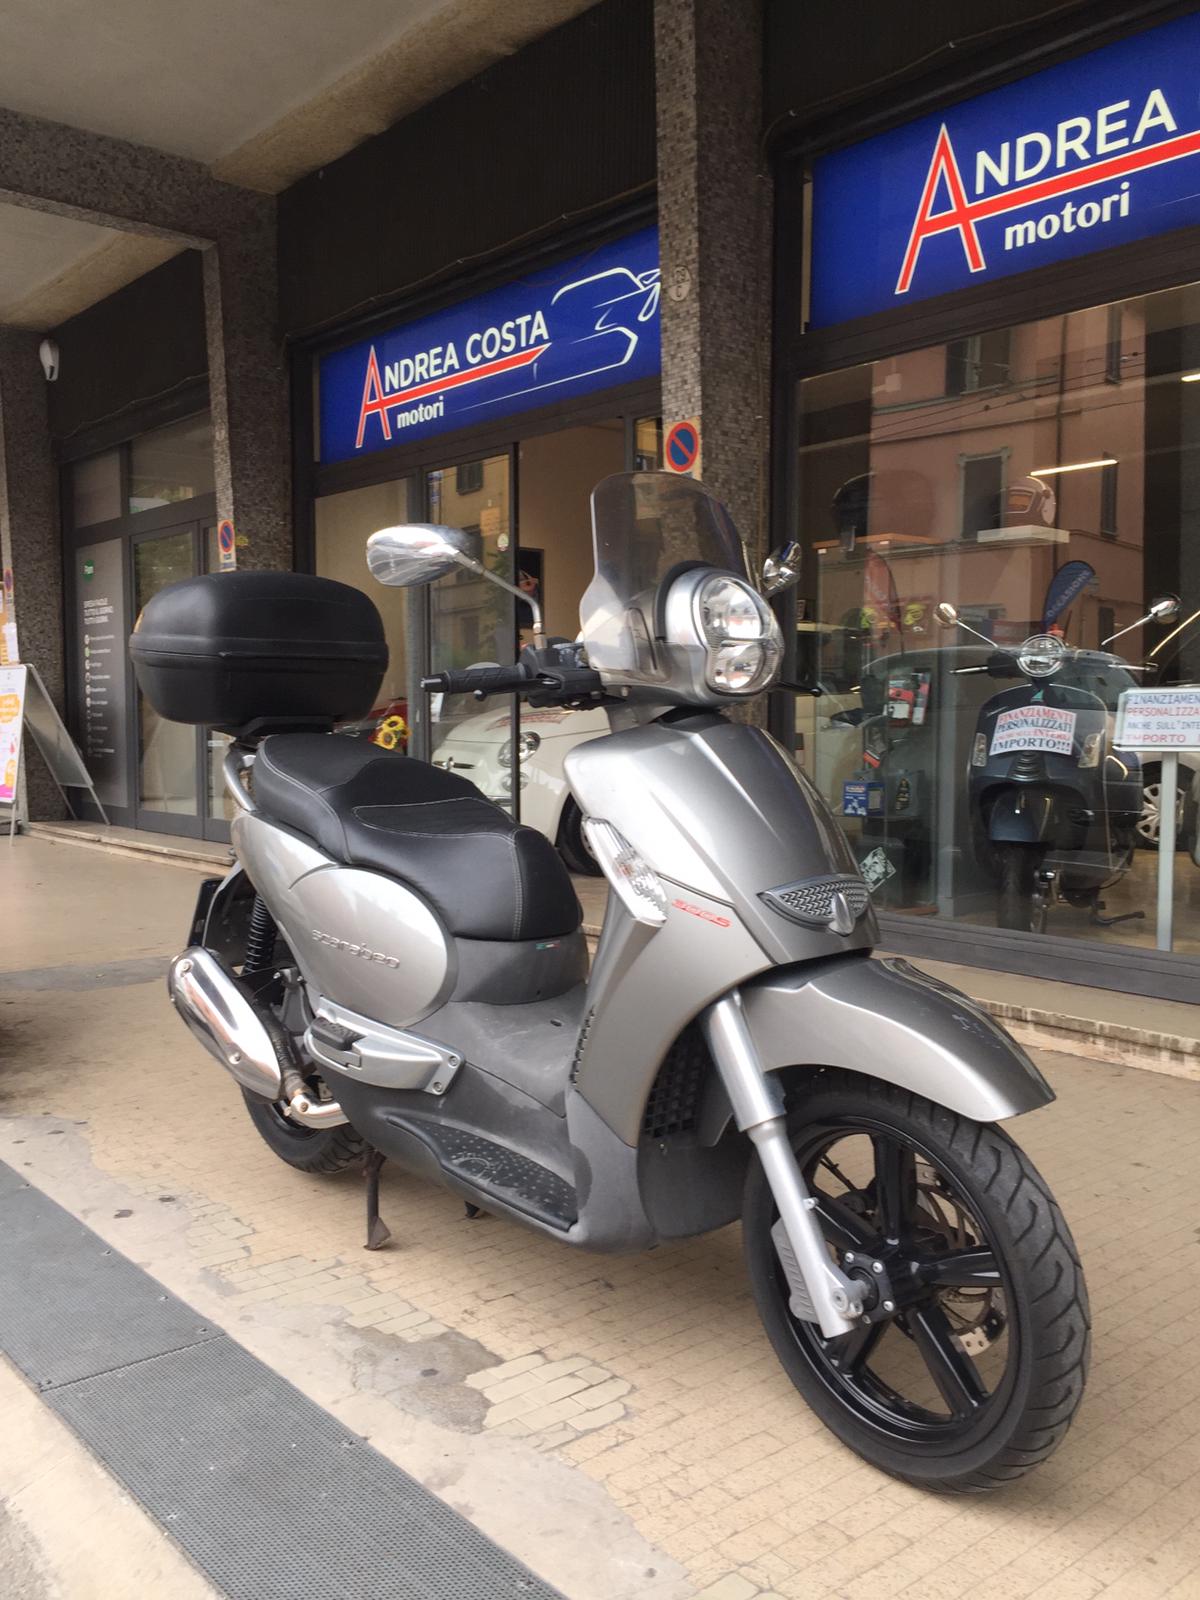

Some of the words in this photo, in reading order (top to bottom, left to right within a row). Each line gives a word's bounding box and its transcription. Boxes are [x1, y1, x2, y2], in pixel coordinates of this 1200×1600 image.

[895, 88, 1178, 295] ANDREA
[1004, 181, 1130, 250] motori
[355, 342, 460, 449] ANDREA
[465, 310, 549, 364] COSTA
[396, 396, 444, 429] motori
[992, 737, 1071, 752] IMPORTO!!!
[312, 929, 400, 969] scarabeo
